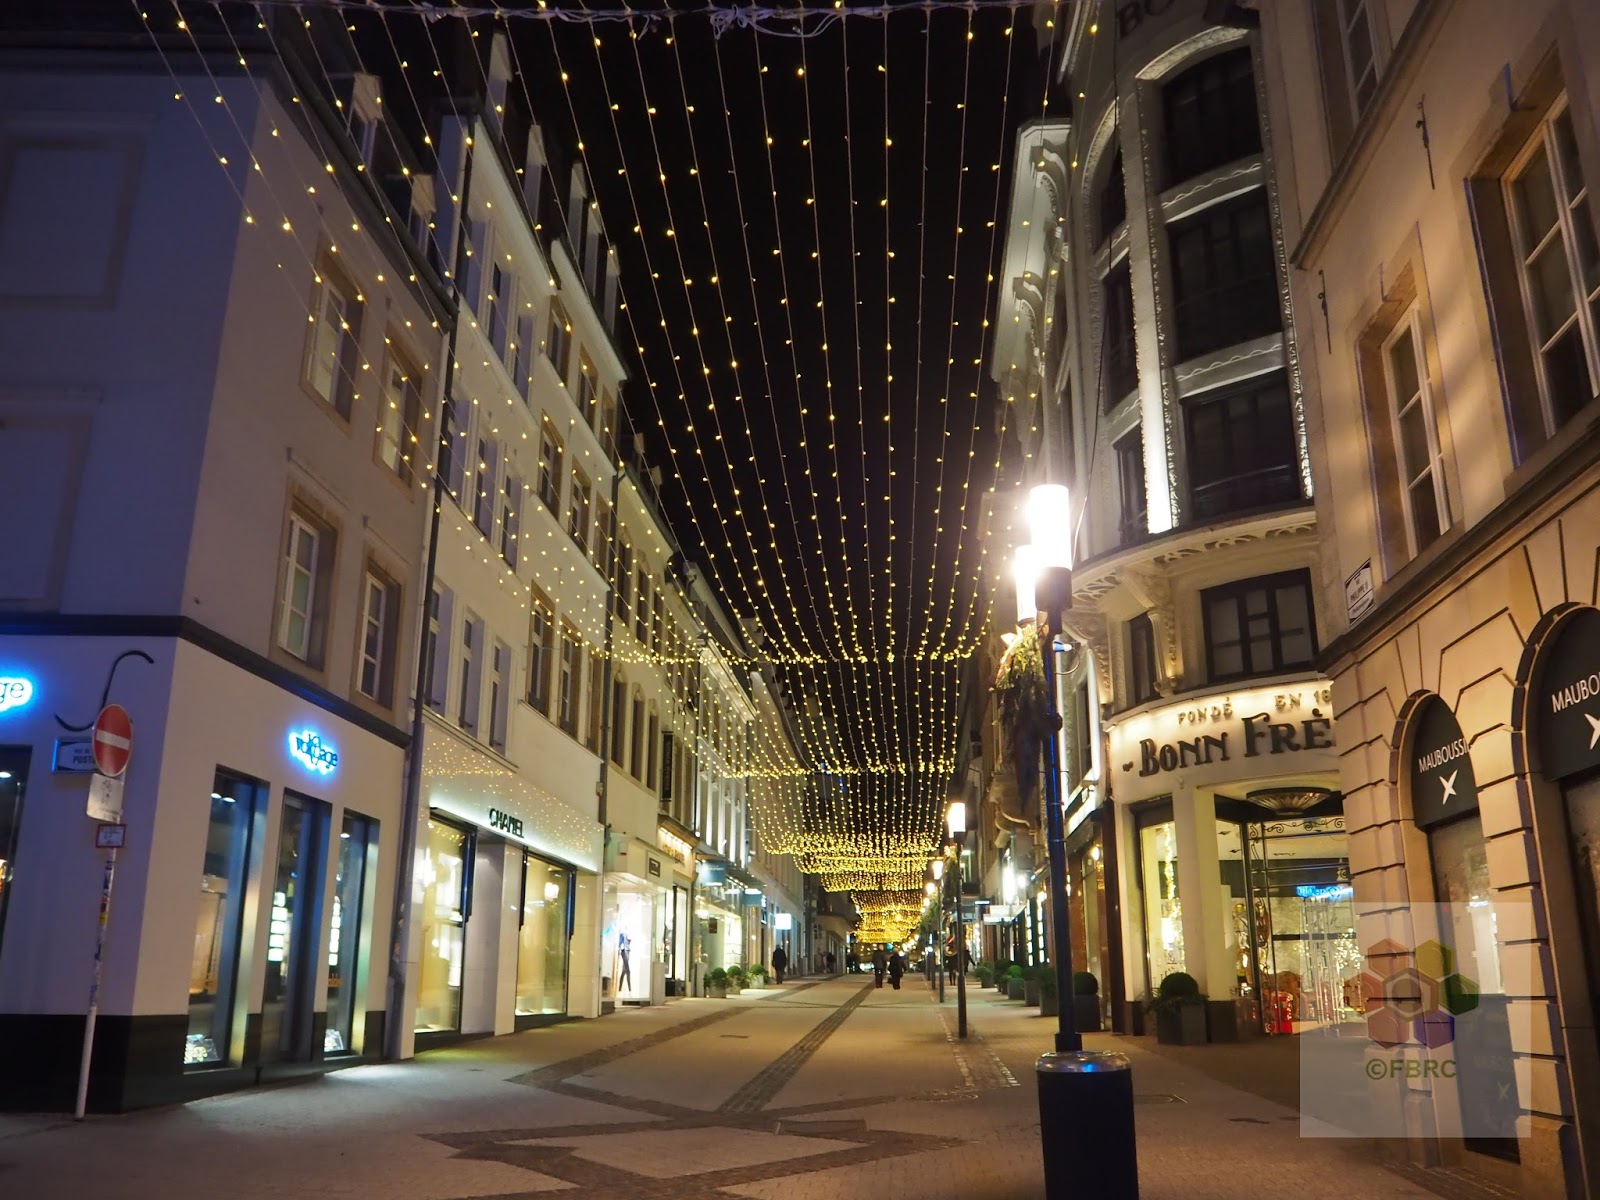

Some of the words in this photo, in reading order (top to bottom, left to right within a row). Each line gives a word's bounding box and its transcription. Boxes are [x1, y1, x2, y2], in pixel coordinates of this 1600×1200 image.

[1274, 693, 1302, 711] EN
[1551, 672, 1600, 714] MAUBO
[489, 807, 525, 839] CHANEL
